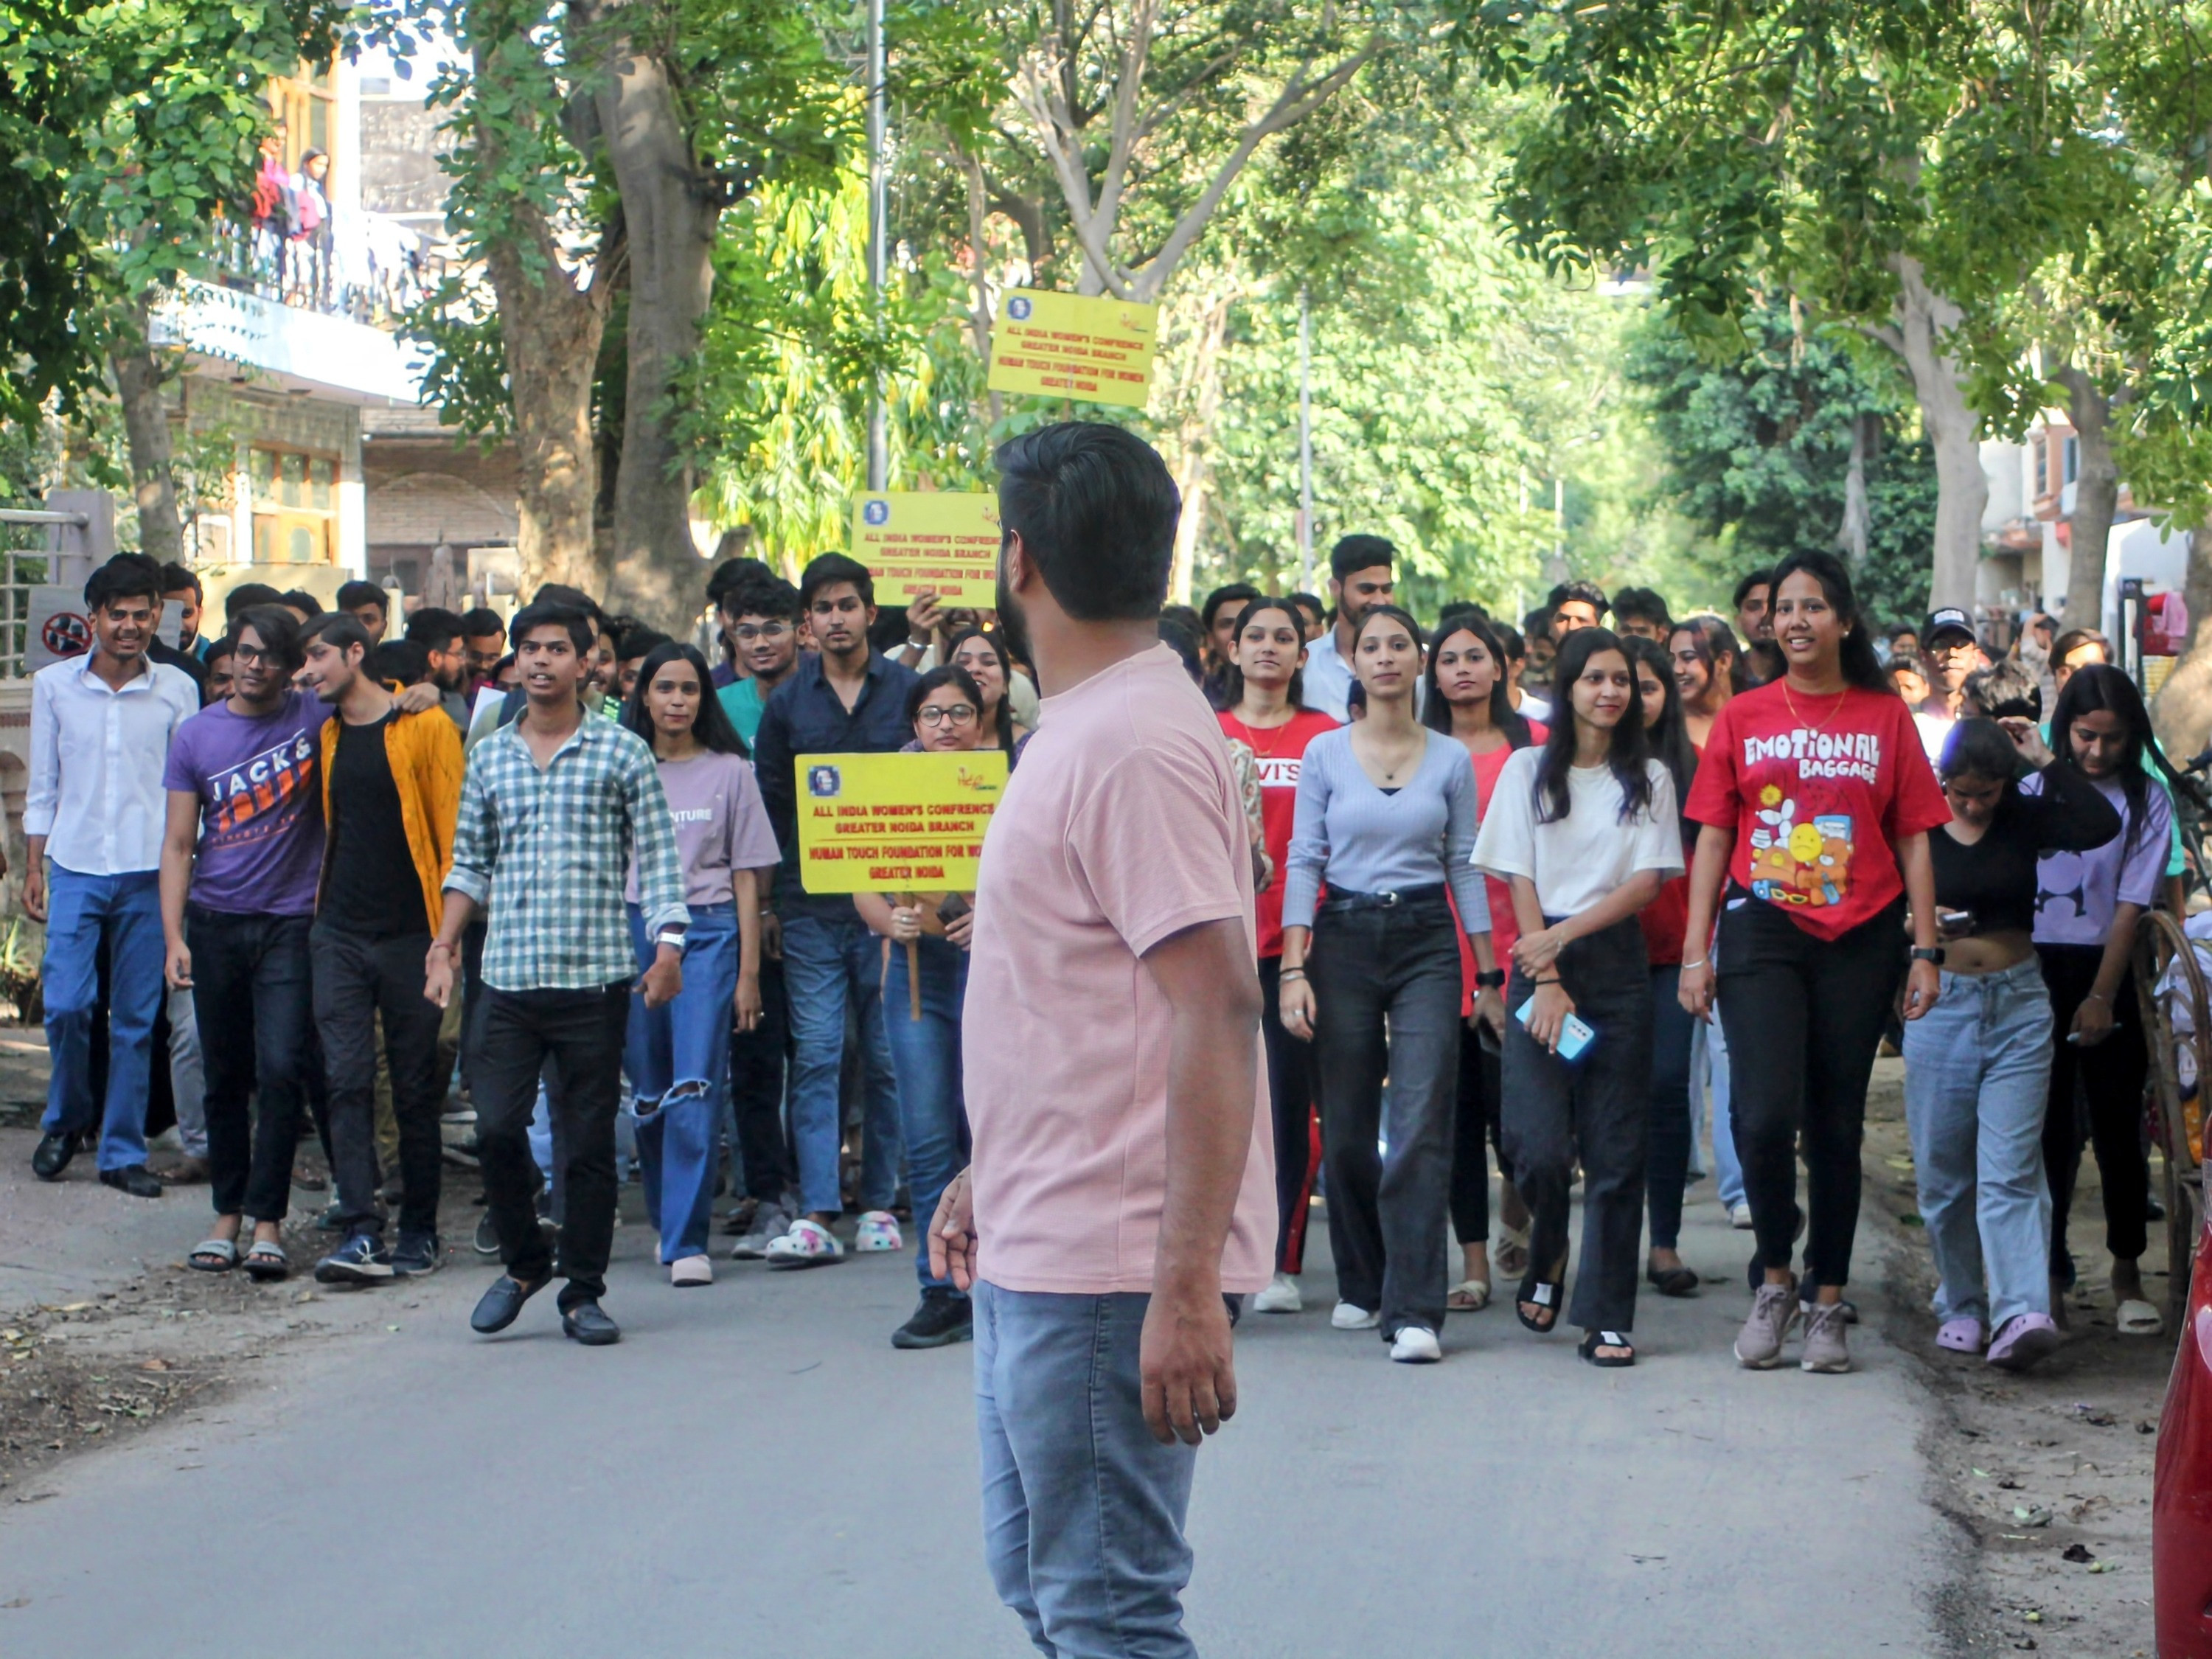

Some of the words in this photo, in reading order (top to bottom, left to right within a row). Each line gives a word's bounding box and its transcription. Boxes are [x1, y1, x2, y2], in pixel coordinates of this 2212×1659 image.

[865, 533, 880, 542] ALL
[213, 748, 291, 801] JACK
[296, 738, 310, 759] &
[1799, 759, 1877, 785] BAGGAGE
[813, 806, 833, 817] ALL
[838, 806, 868, 816] INDIA
[872, 804, 922, 816] WOMEN'S
[835, 822, 886, 833] GREATER
[890, 822, 924, 832] NOIDA
[928, 821, 974, 832] BRANCH
[810, 846, 844, 860] HUMAN
[847, 846, 879, 859] TOUCH
[882, 845, 942, 858] FOUNDATION
[945, 845, 964, 857] FOR
[869, 866, 912, 879] GREATER
[915, 866, 945, 878] NOIDA
